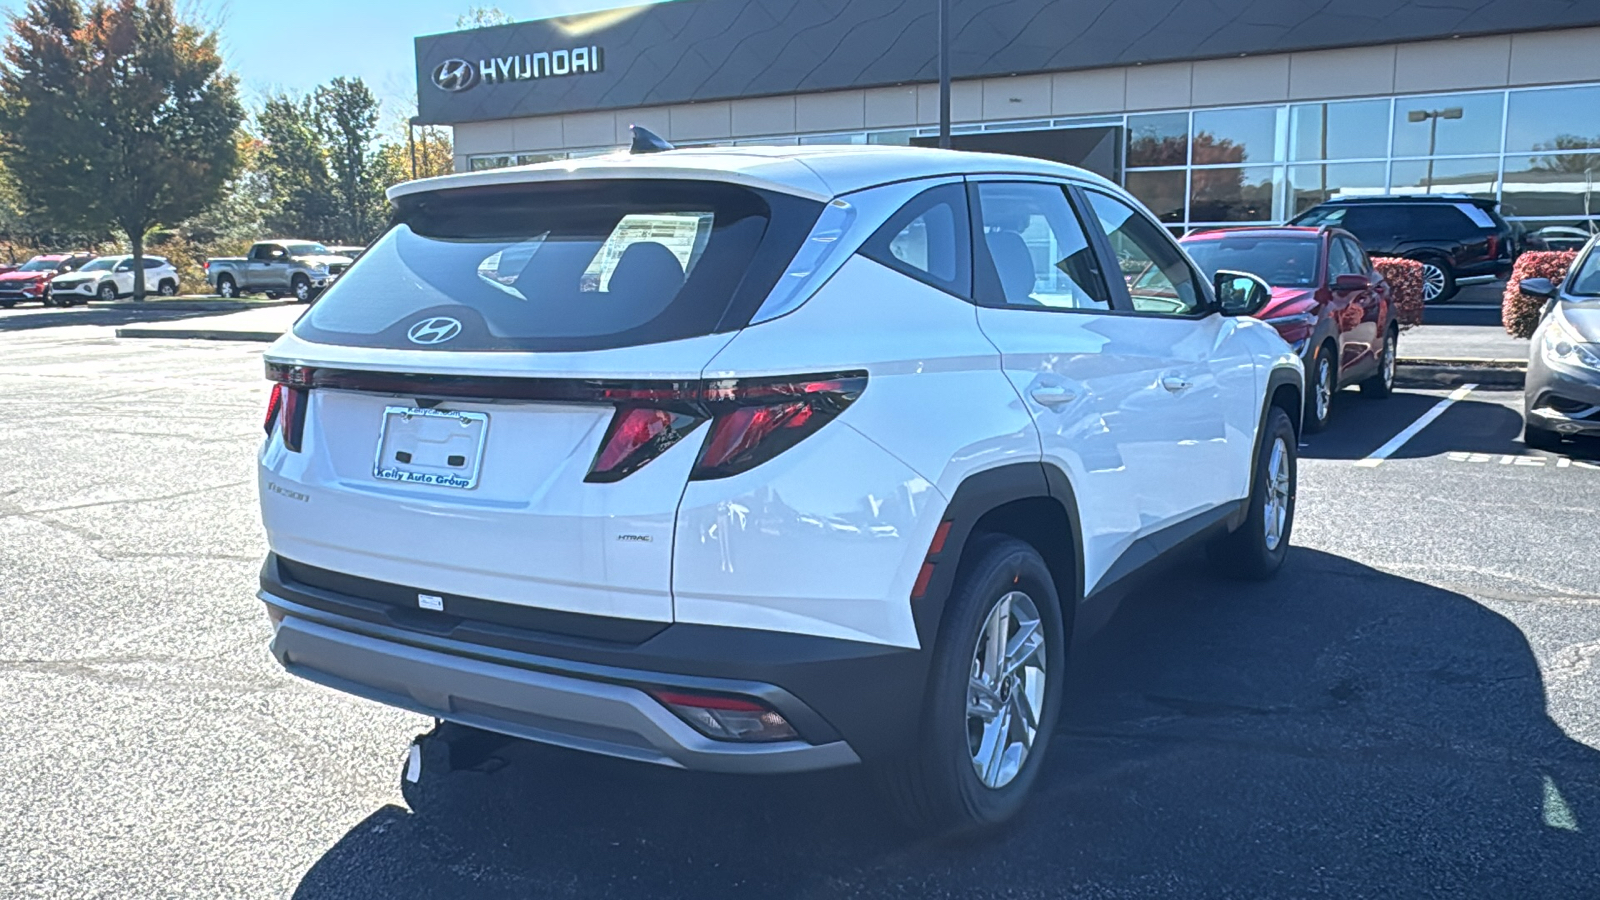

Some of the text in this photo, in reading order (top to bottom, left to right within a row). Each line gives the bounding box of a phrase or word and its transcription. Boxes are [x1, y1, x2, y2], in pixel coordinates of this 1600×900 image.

[479, 46, 598, 82] HYUNDAI
[376, 469, 470, 488] Kelly Auto Group
[618, 534, 650, 542] HTRAC
